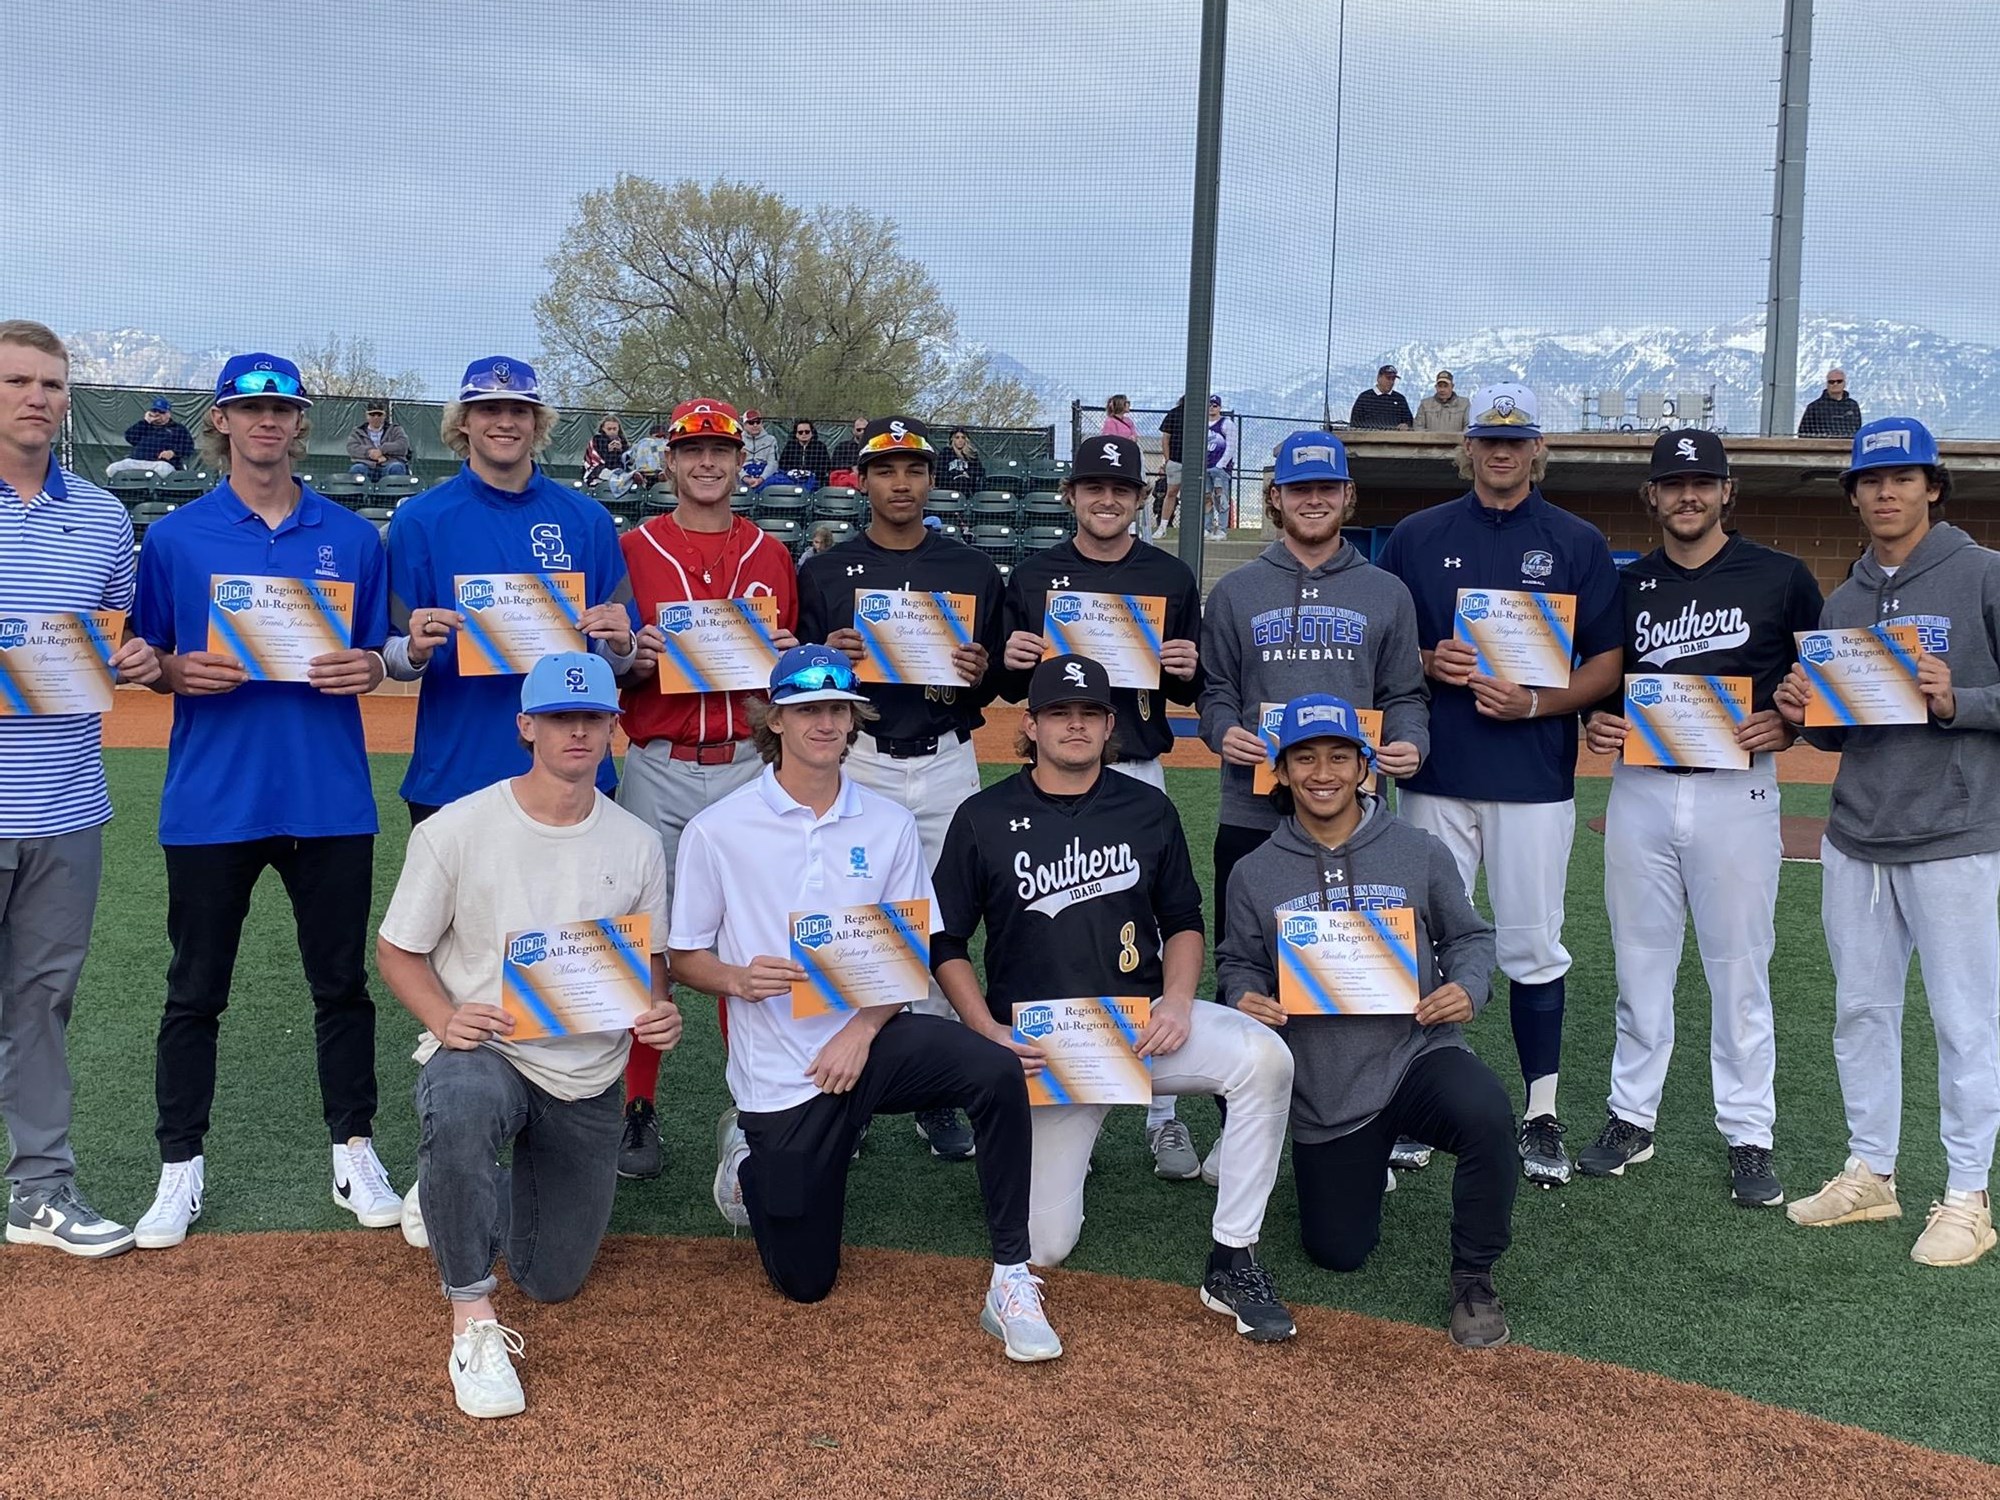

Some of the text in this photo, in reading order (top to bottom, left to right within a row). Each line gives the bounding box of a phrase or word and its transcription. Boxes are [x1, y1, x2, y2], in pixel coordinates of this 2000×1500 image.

[1100, 443, 1122, 467] SI
[1675, 438, 1699, 461] SI
[530, 523, 571, 570] SL
[216, 585, 253, 601] NJCAA
[265, 584, 337, 598] Region XVIII
[461, 583, 494, 601] NJCAA
[505, 580, 569, 593] Region XVIII
[254, 599, 347, 612] All-Region Award
[496, 593, 580, 606] All-Region Award
[860, 598, 890, 613] NJCAA
[901, 598, 961, 609] Region XVIII
[1051, 598, 1081, 613] NJCAA
[1092, 600, 1152, 612] Region XVIII
[1461, 597, 1490, 612] NJCAA
[1501, 597, 1561, 609] Region XVIII
[661, 609, 692, 625] NJCAA
[702, 603, 762, 616] Region XVIII
[891, 611, 969, 622] All-Region Award
[1489, 609, 1538, 622] All-Region
[1541, 613, 1570, 623] Award
[41, 618, 109, 633] Region XVIII
[694, 617, 741, 628] All-Region
[743, 615, 772, 625] Award
[1082, 612, 1129, 624] All-Region
[1131, 614, 1160, 625] Award
[0, 620, 28, 636] CAA
[1635, 600, 1745, 653] Southern
[28, 631, 117, 647] All-Region Award
[1842, 635, 1875, 646] Region
[1877, 632, 1904, 643] XVIII
[1679, 640, 1709, 655] IDAHO
[1801, 639, 1832, 655] NJCAA
[1836, 648, 1885, 659] All-Region
[1887, 646, 1917, 656] Award
[1262, 648, 1355, 662] BASEBALL
[565, 667, 589, 694] SL
[1063, 662, 1088, 688] SI
[1631, 683, 1662, 697] NJCAA
[1673, 681, 1737, 692] Region XVIII
[1663, 694, 1714, 705] All-Region
[1716, 696, 1747, 705] Award
[1264, 711, 1284, 727] NJC
[1359, 729, 1376, 739] ard
[1014, 837, 1134, 900] Southern
[1070, 883, 1102, 901] IDAHO
[844, 907, 914, 926] Region XVIII
[1329, 916, 1398, 930] Region XVIII
[560, 923, 632, 942] Region XVIII
[796, 919, 832, 939] NJCAA
[834, 921, 924, 940] All-Region Award
[1284, 920, 1318, 936] NJCAA
[1320, 931, 1409, 945] All-Region Award
[510, 936, 547, 959] NJCAA
[548, 938, 644, 957] All-Region Award
[553, 959, 617, 976] Mason Green
[1065, 1005, 1134, 1017] Region XVIII
[1019, 1010, 1053, 1029] NJCAA
[1055, 1020, 1145, 1032] All-Region Award
